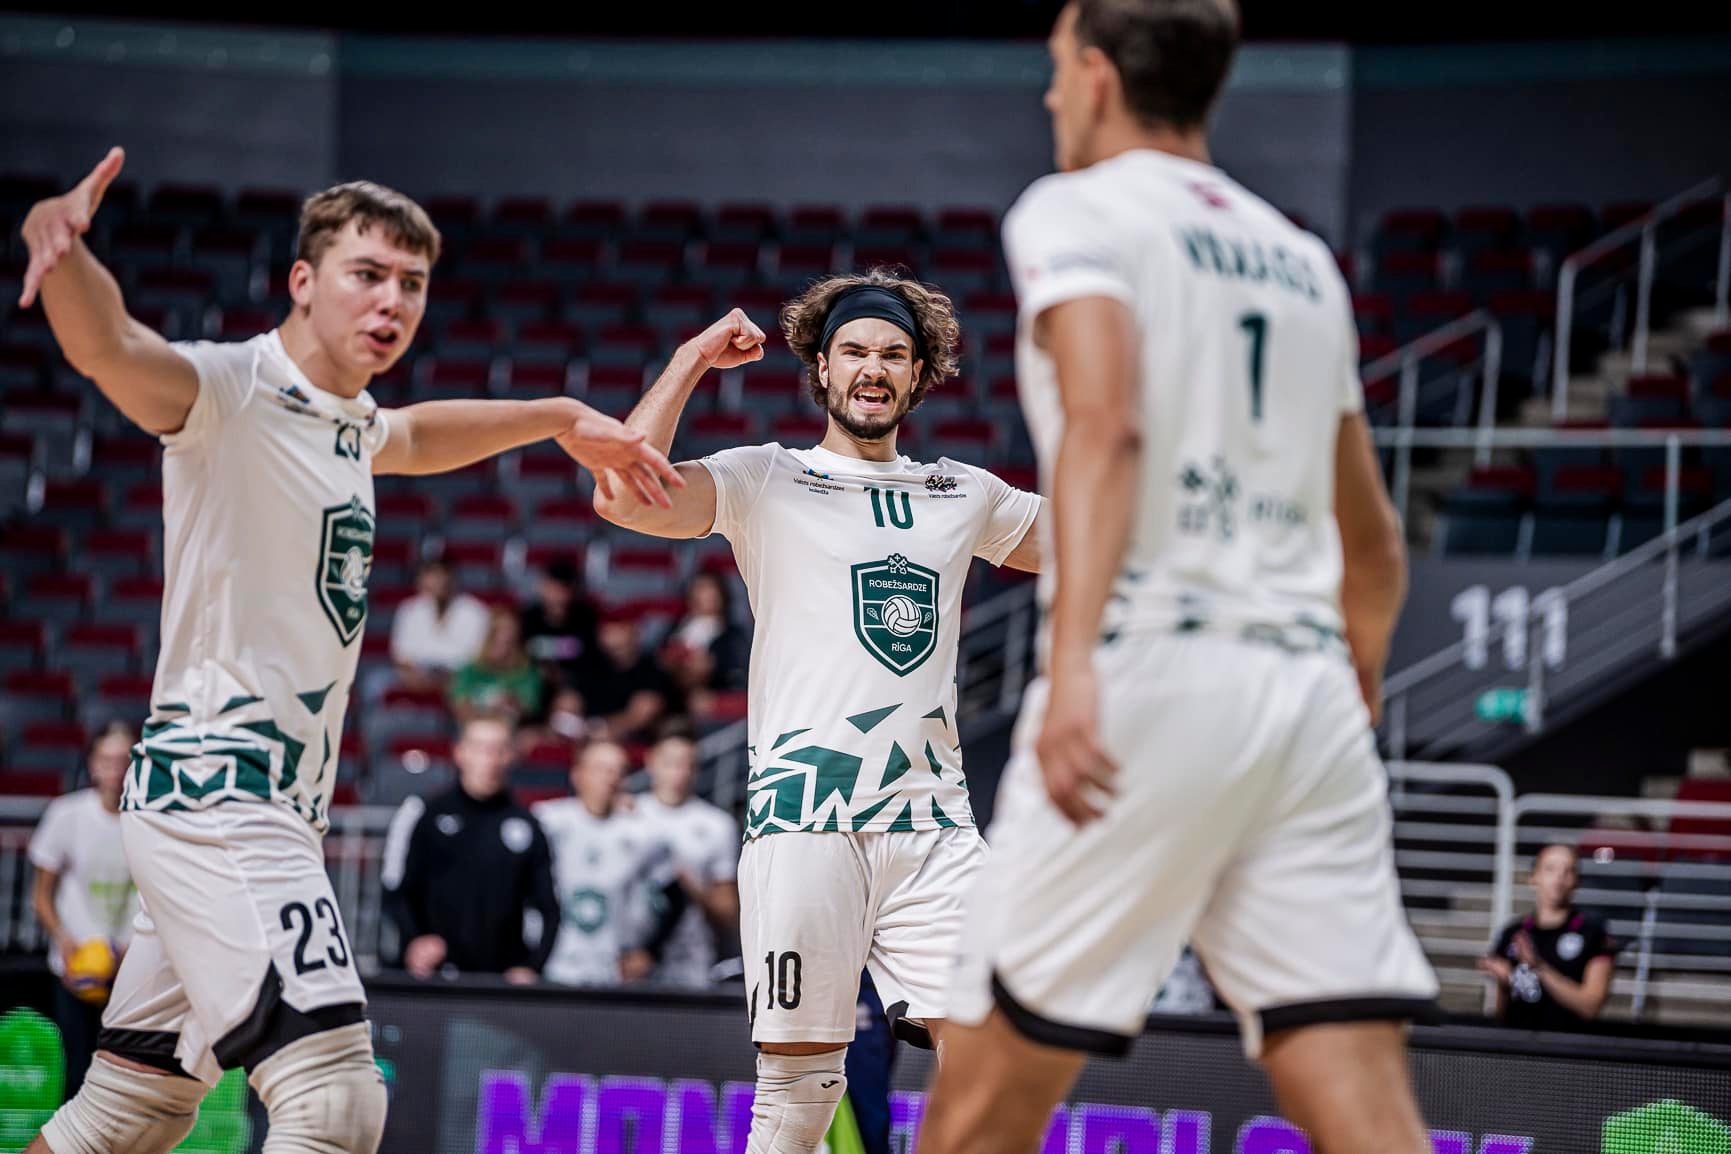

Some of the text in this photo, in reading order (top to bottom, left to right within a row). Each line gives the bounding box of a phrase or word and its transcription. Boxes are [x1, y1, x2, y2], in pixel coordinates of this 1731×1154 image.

[1237, 311, 1267, 422] 1
[863, 486, 914, 530] 10
[868, 579, 928, 593] ROBEŽSARDZE
[891, 641, 912, 653] RĪGA
[1450, 583, 1568, 671] 111
[279, 897, 349, 976] 23
[765, 950, 802, 1010] 10
